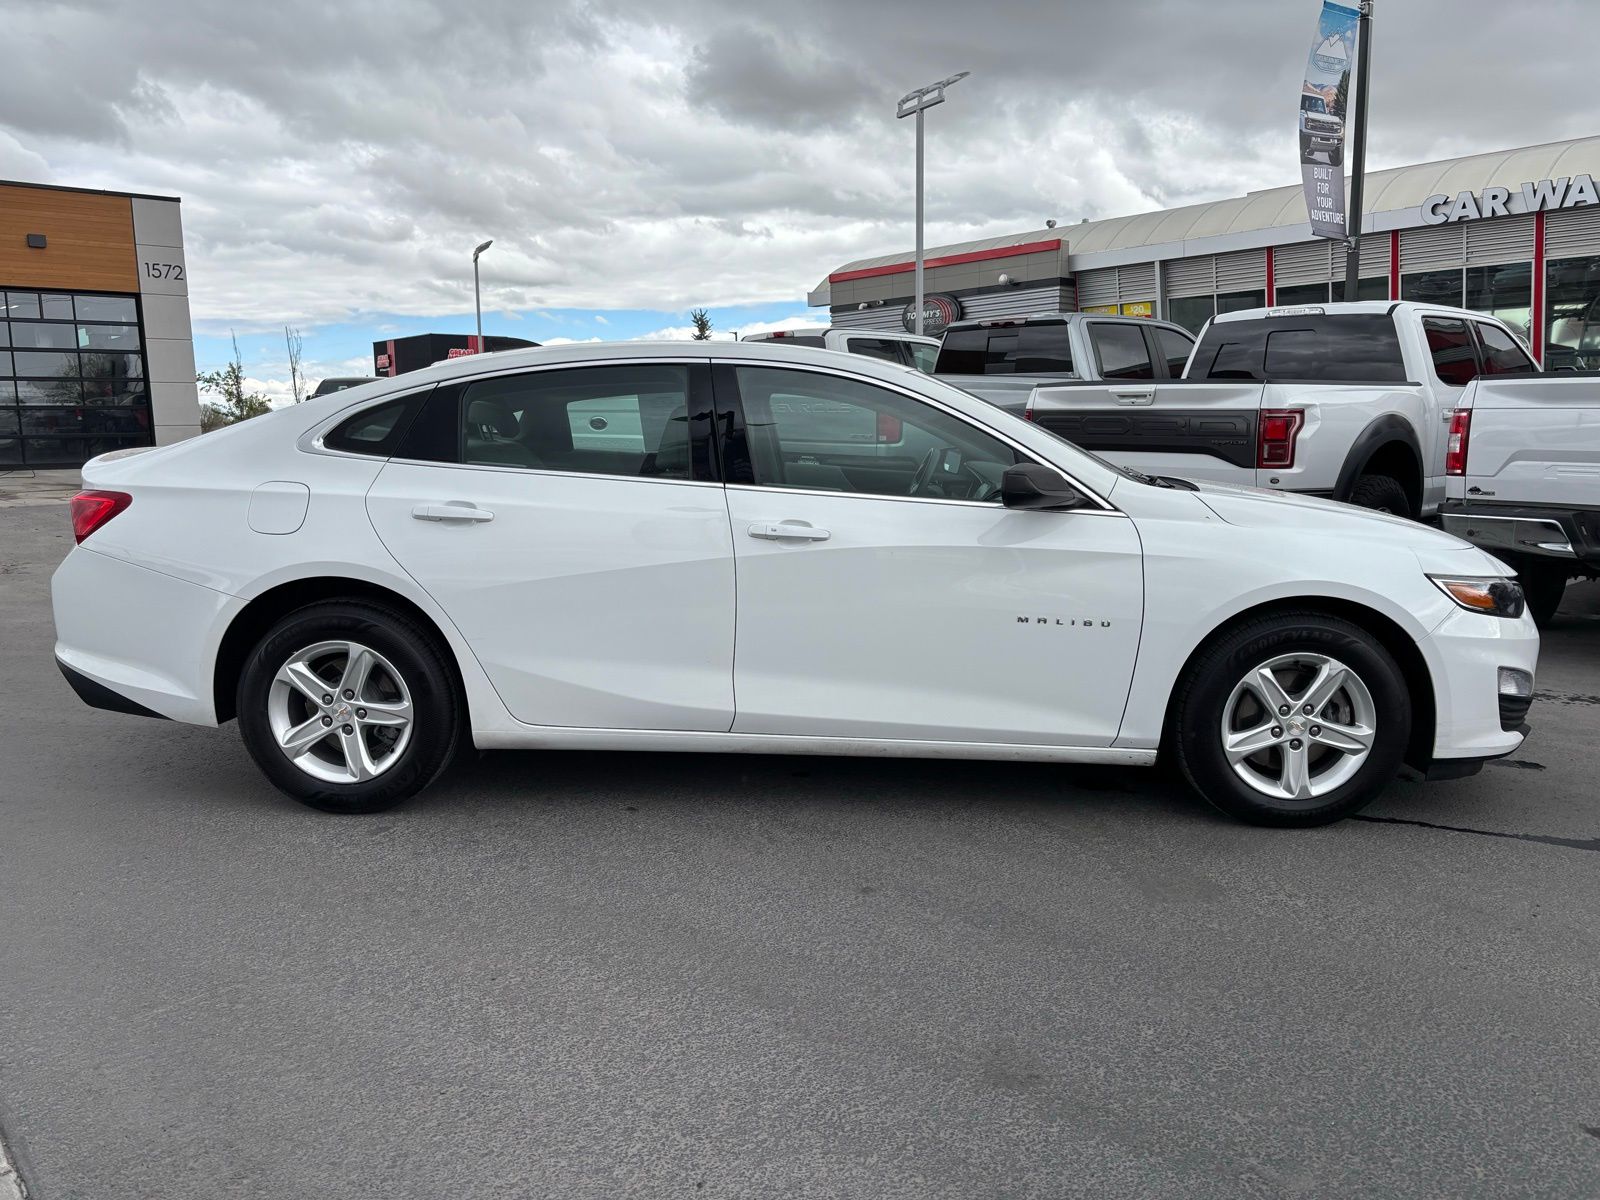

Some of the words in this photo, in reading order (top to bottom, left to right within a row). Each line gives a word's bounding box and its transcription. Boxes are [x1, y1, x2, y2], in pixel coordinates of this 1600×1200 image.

[1314, 168, 1332, 180] BUILT
[1317, 182, 1329, 194] FOR
[1316, 196, 1333, 208] YOUR
[1421, 187, 1511, 225] CAR
[1521, 174, 1600, 211] WA
[1311, 209, 1344, 224] ADVENTURE
[144, 262, 184, 280] 1572
[906, 309, 941, 320] TOMY'S
[1017, 616, 1110, 627] MALIBU
